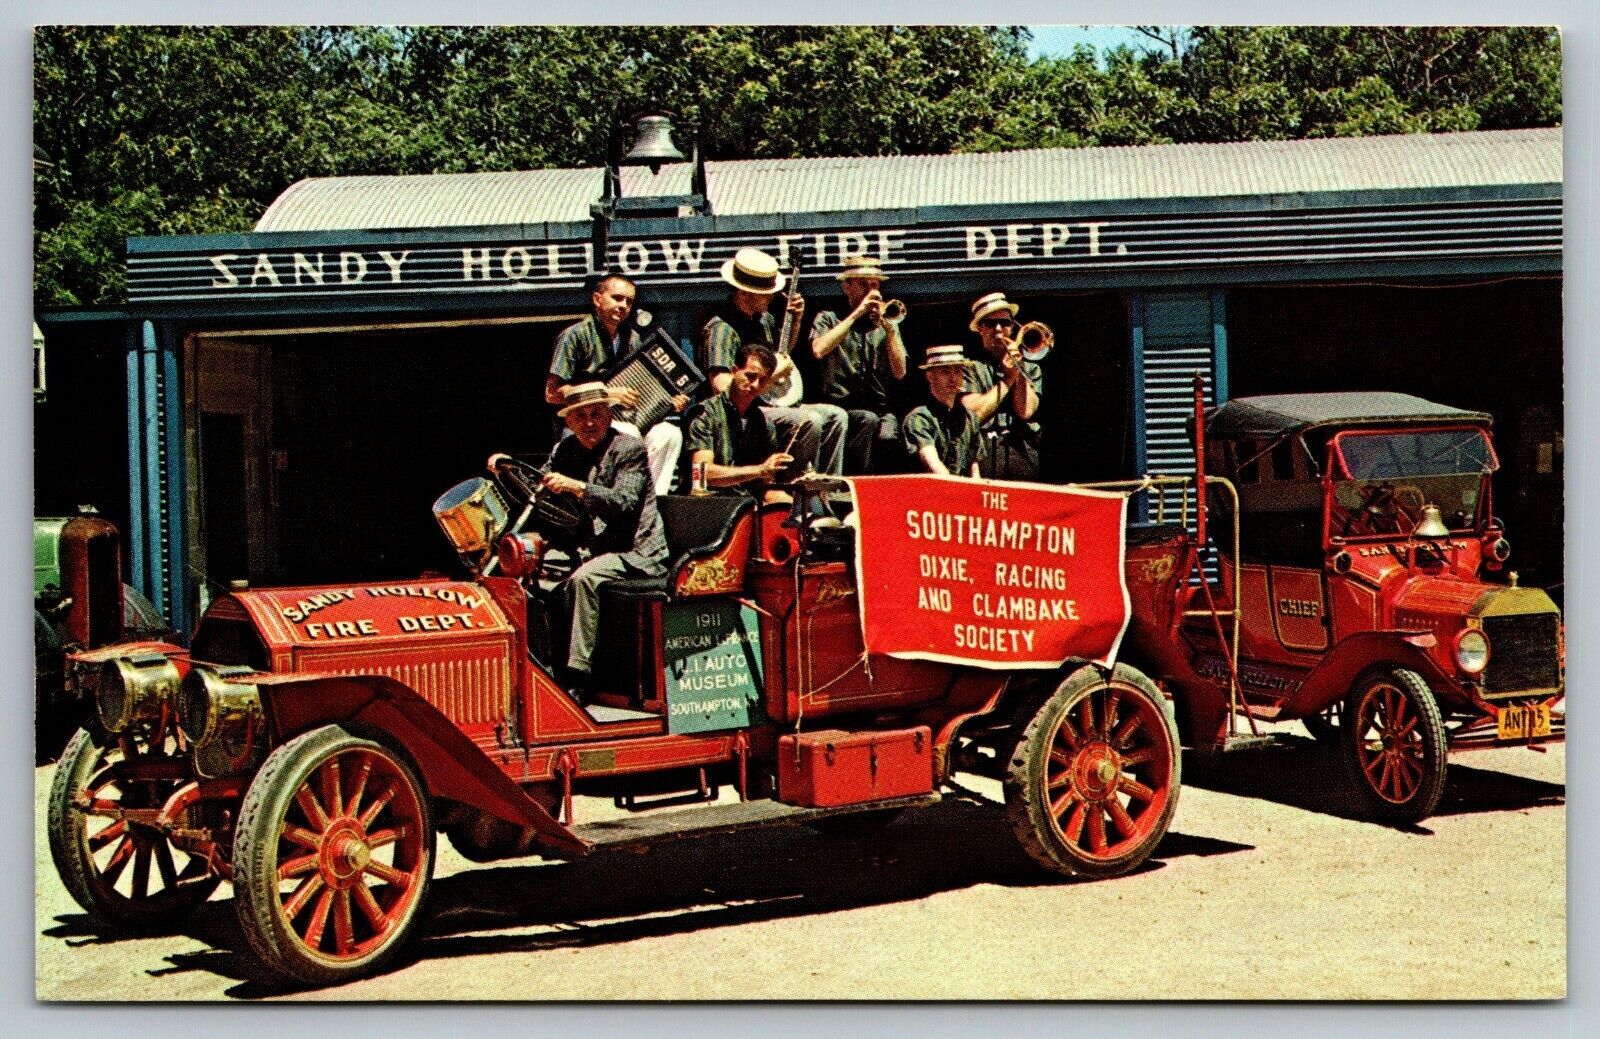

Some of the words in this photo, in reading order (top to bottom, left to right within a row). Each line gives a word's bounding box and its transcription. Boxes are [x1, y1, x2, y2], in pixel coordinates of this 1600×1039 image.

[208, 250, 413, 289] SANDY
[778, 229, 908, 268] FIRE
[963, 221, 1127, 261] DEPT.
[981, 490, 1008, 511] THE
[906, 509, 1076, 556] SOUTHAMPTON
[919, 553, 975, 585] DIXIE,
[995, 562, 1067, 591] RACING
[282, 588, 357, 623] SANDY
[365, 585, 486, 610] HOLLOW
[917, 586, 952, 613] AND
[972, 593, 1080, 621] CLAMBAKE
[1279, 598, 1320, 617] CHIEF
[305, 618, 380, 640] FIRE
[398, 612, 486, 633] DEPT.
[696, 613, 721, 628] 1911
[953, 624, 1035, 653] SOCIETY
[704, 653, 748, 673] AUTO
[678, 672, 749, 692] MUSEUM
